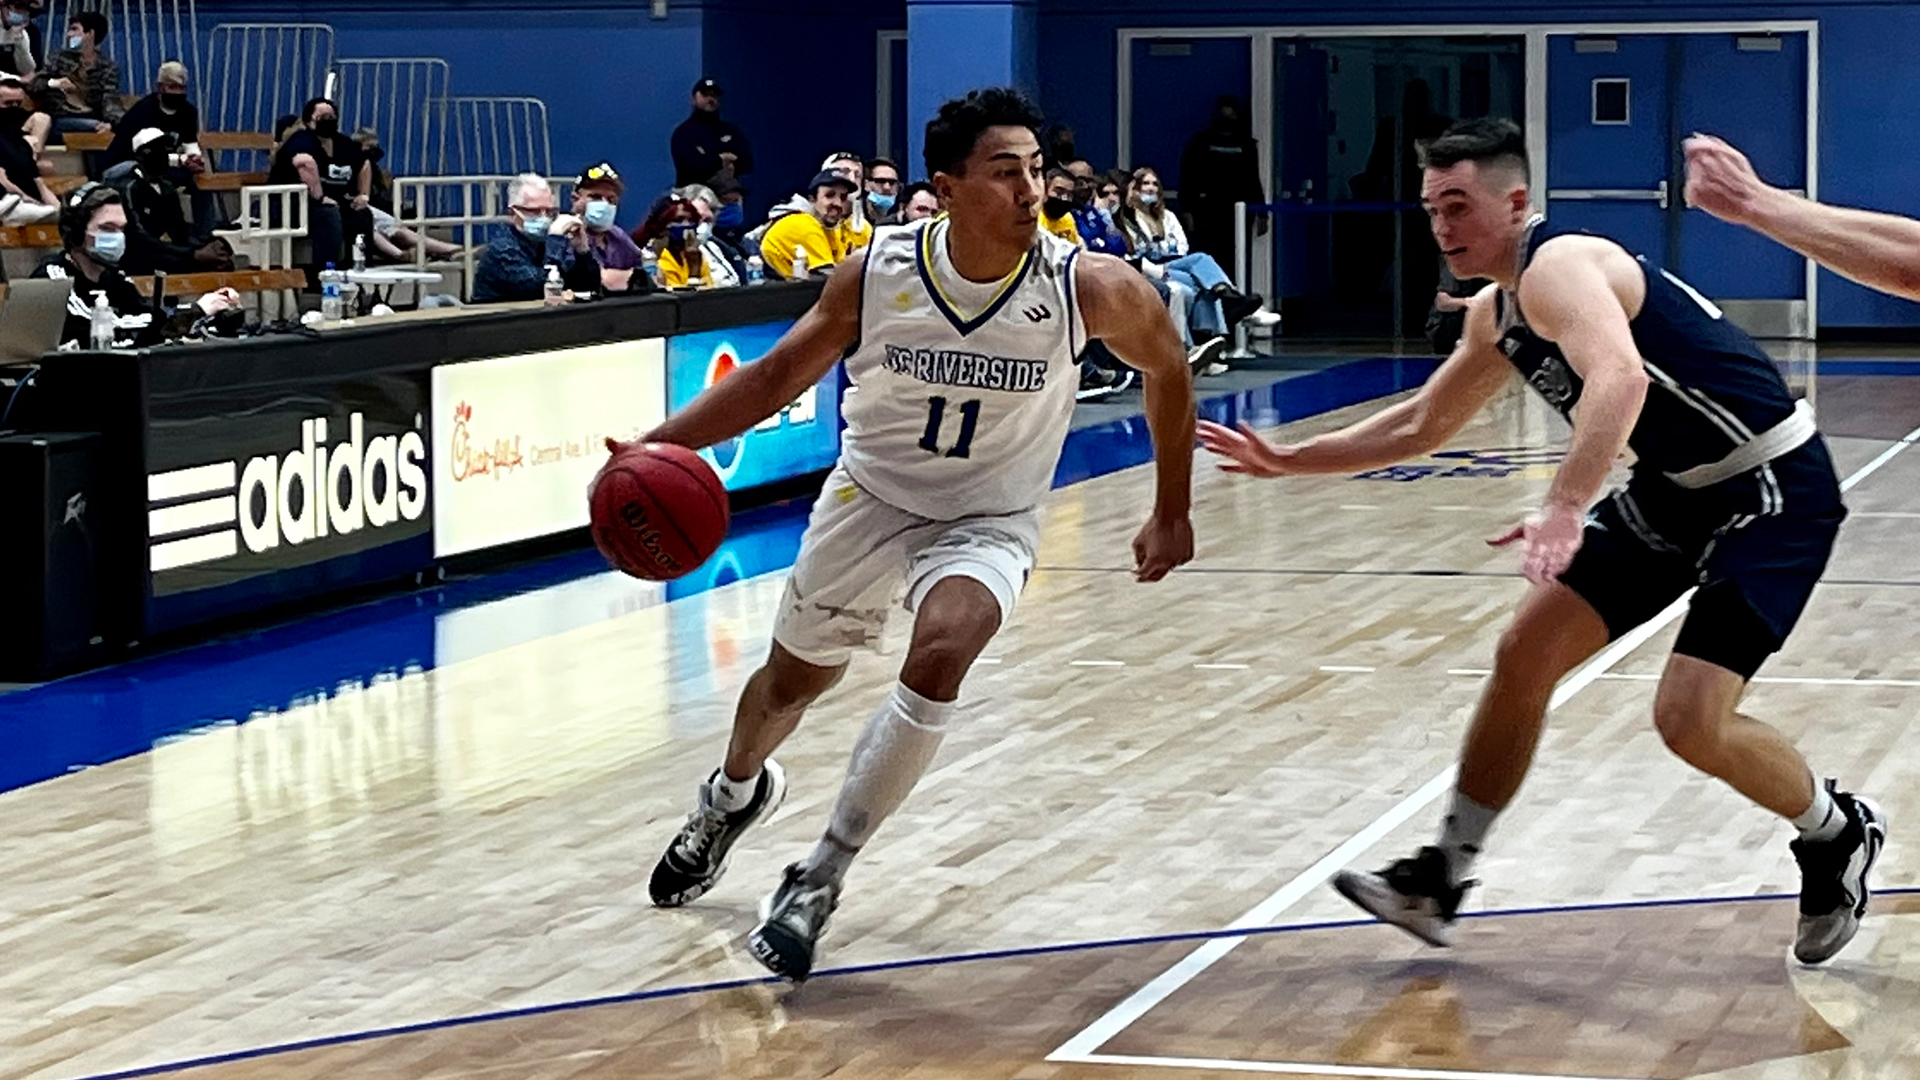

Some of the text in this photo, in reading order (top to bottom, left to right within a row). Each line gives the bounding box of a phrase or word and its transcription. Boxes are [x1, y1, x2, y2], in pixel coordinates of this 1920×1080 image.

[914, 349, 1049, 392] RIVERSIDE
[918, 395, 981, 459] 11
[239, 412, 427, 553] adidas
